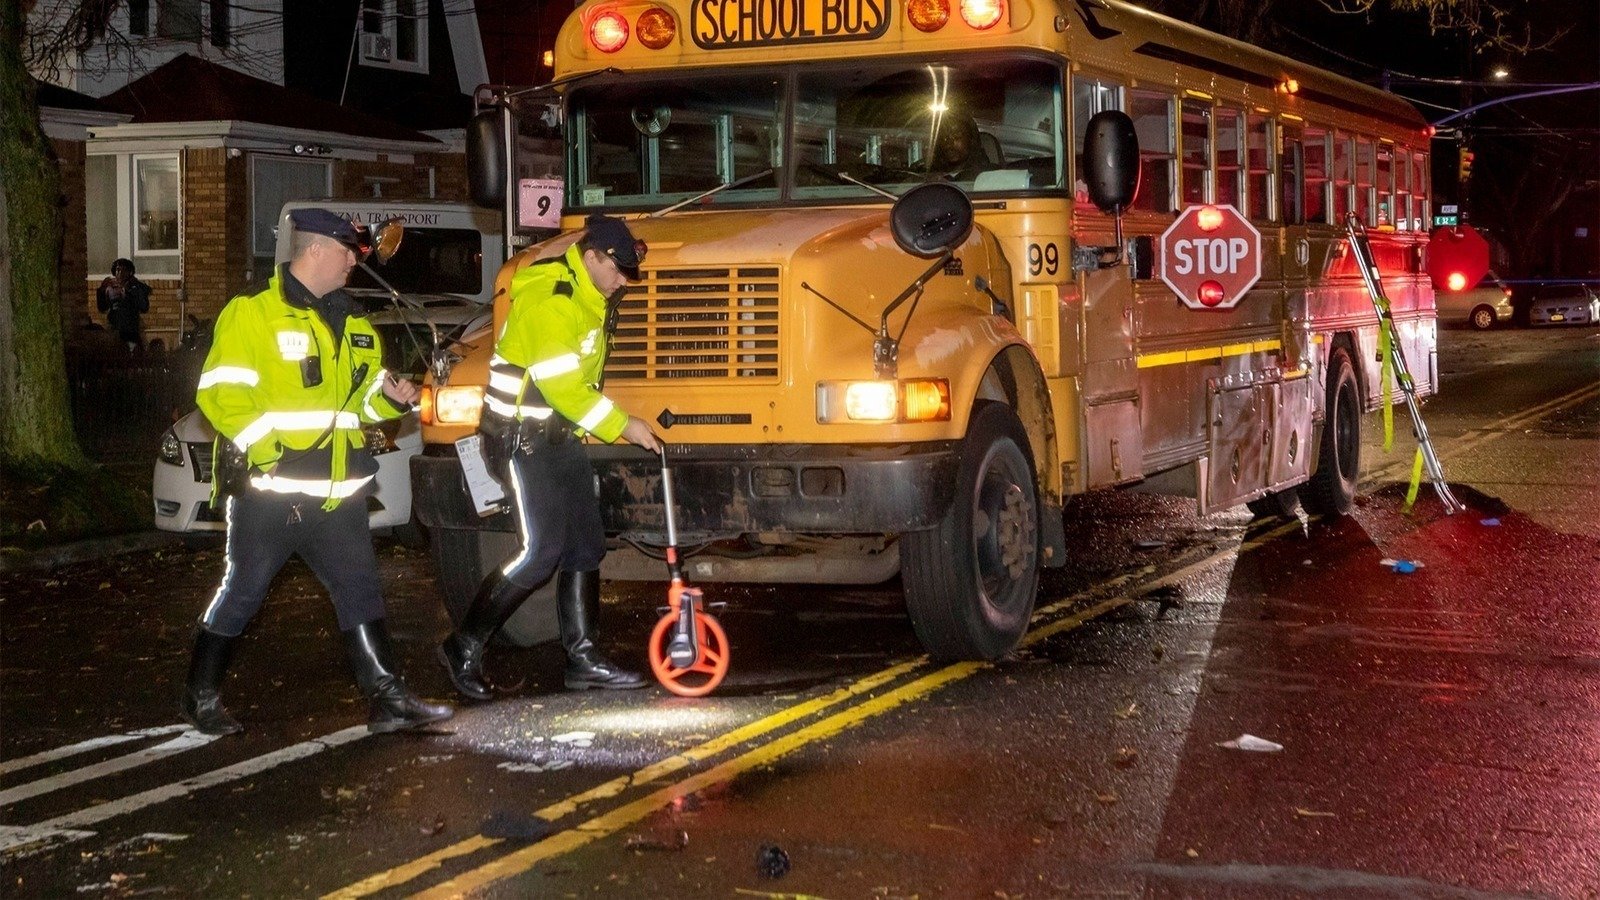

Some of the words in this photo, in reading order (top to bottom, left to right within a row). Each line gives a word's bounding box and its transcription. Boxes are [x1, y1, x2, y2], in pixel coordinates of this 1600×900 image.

[701, 0, 815, 43] SCHOOL
[822, 0, 884, 35] BUS
[367, 211, 440, 225] TRANSPORT
[537, 195, 551, 217] 9
[1442, 217, 1449, 225] 32
[1028, 243, 1059, 276] 99
[1174, 237, 1249, 275] STOP
